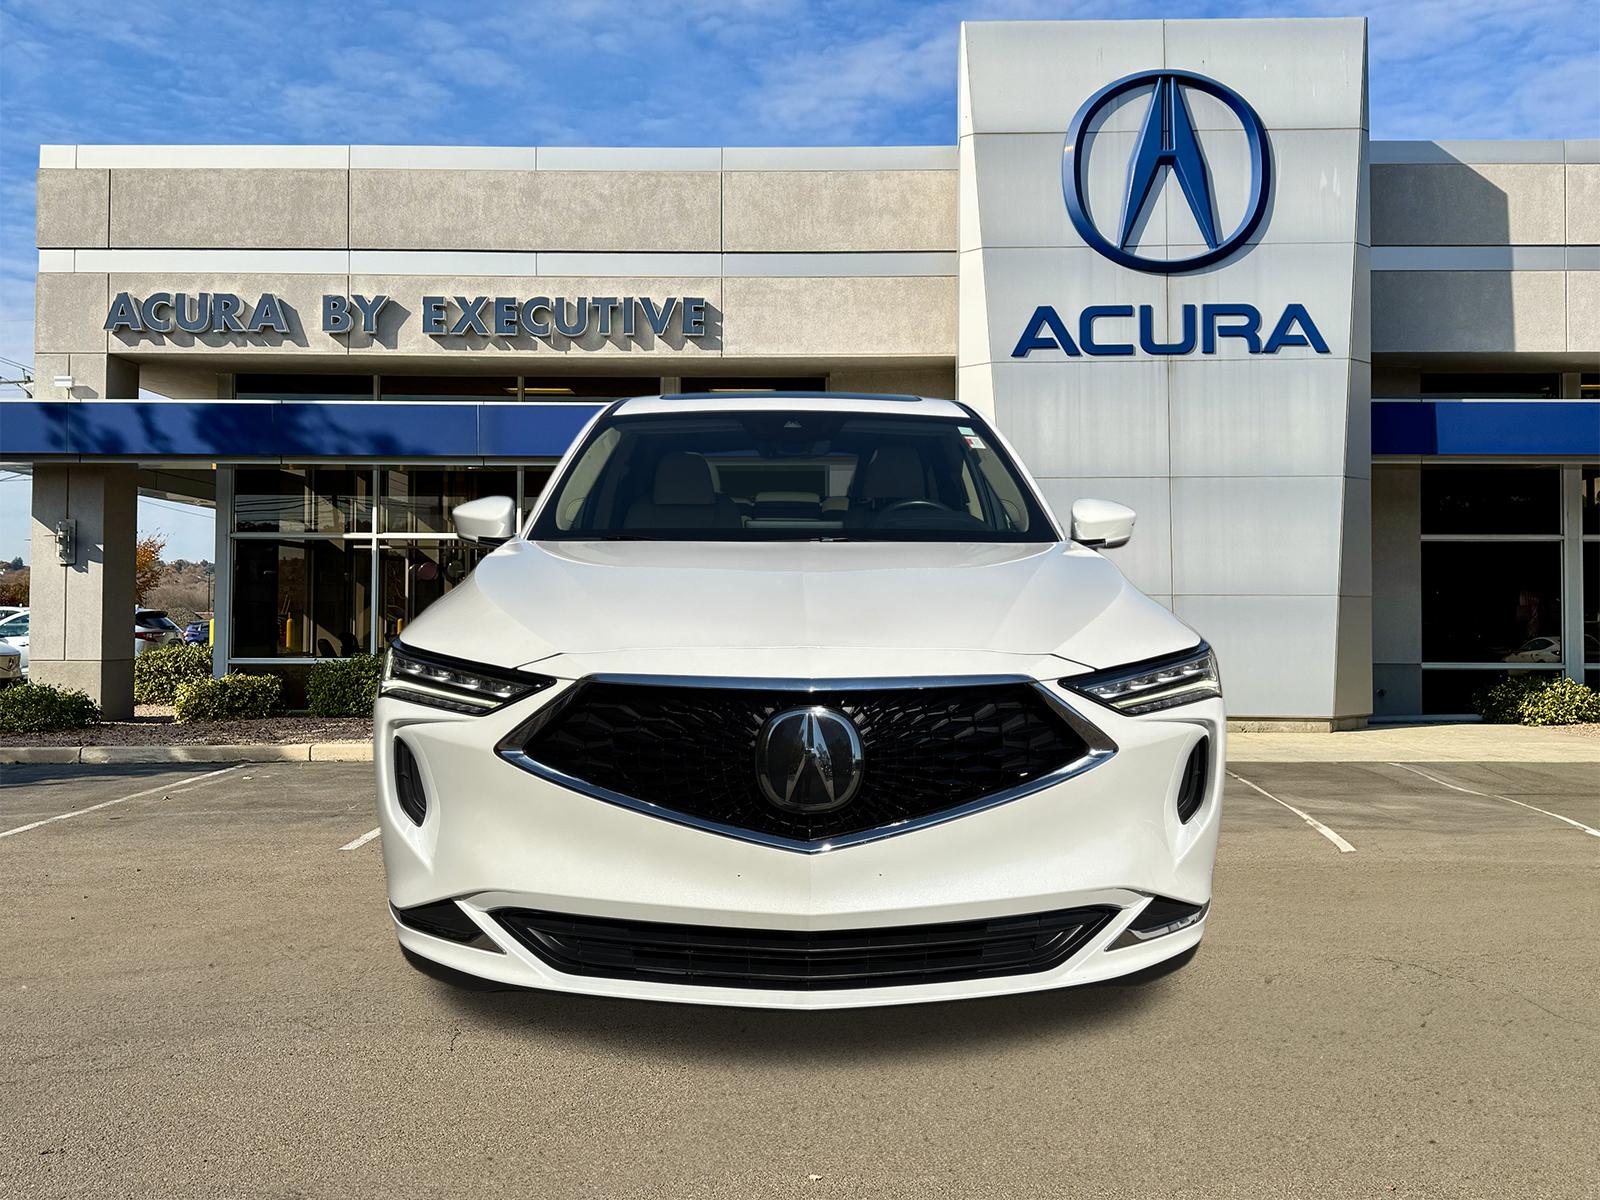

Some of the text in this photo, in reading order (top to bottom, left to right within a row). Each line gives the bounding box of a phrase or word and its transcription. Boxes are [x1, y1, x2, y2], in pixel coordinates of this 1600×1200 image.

[104, 292, 707, 338] ACURA BY EXECUTIVE
[1011, 303, 1331, 357] ACURA
